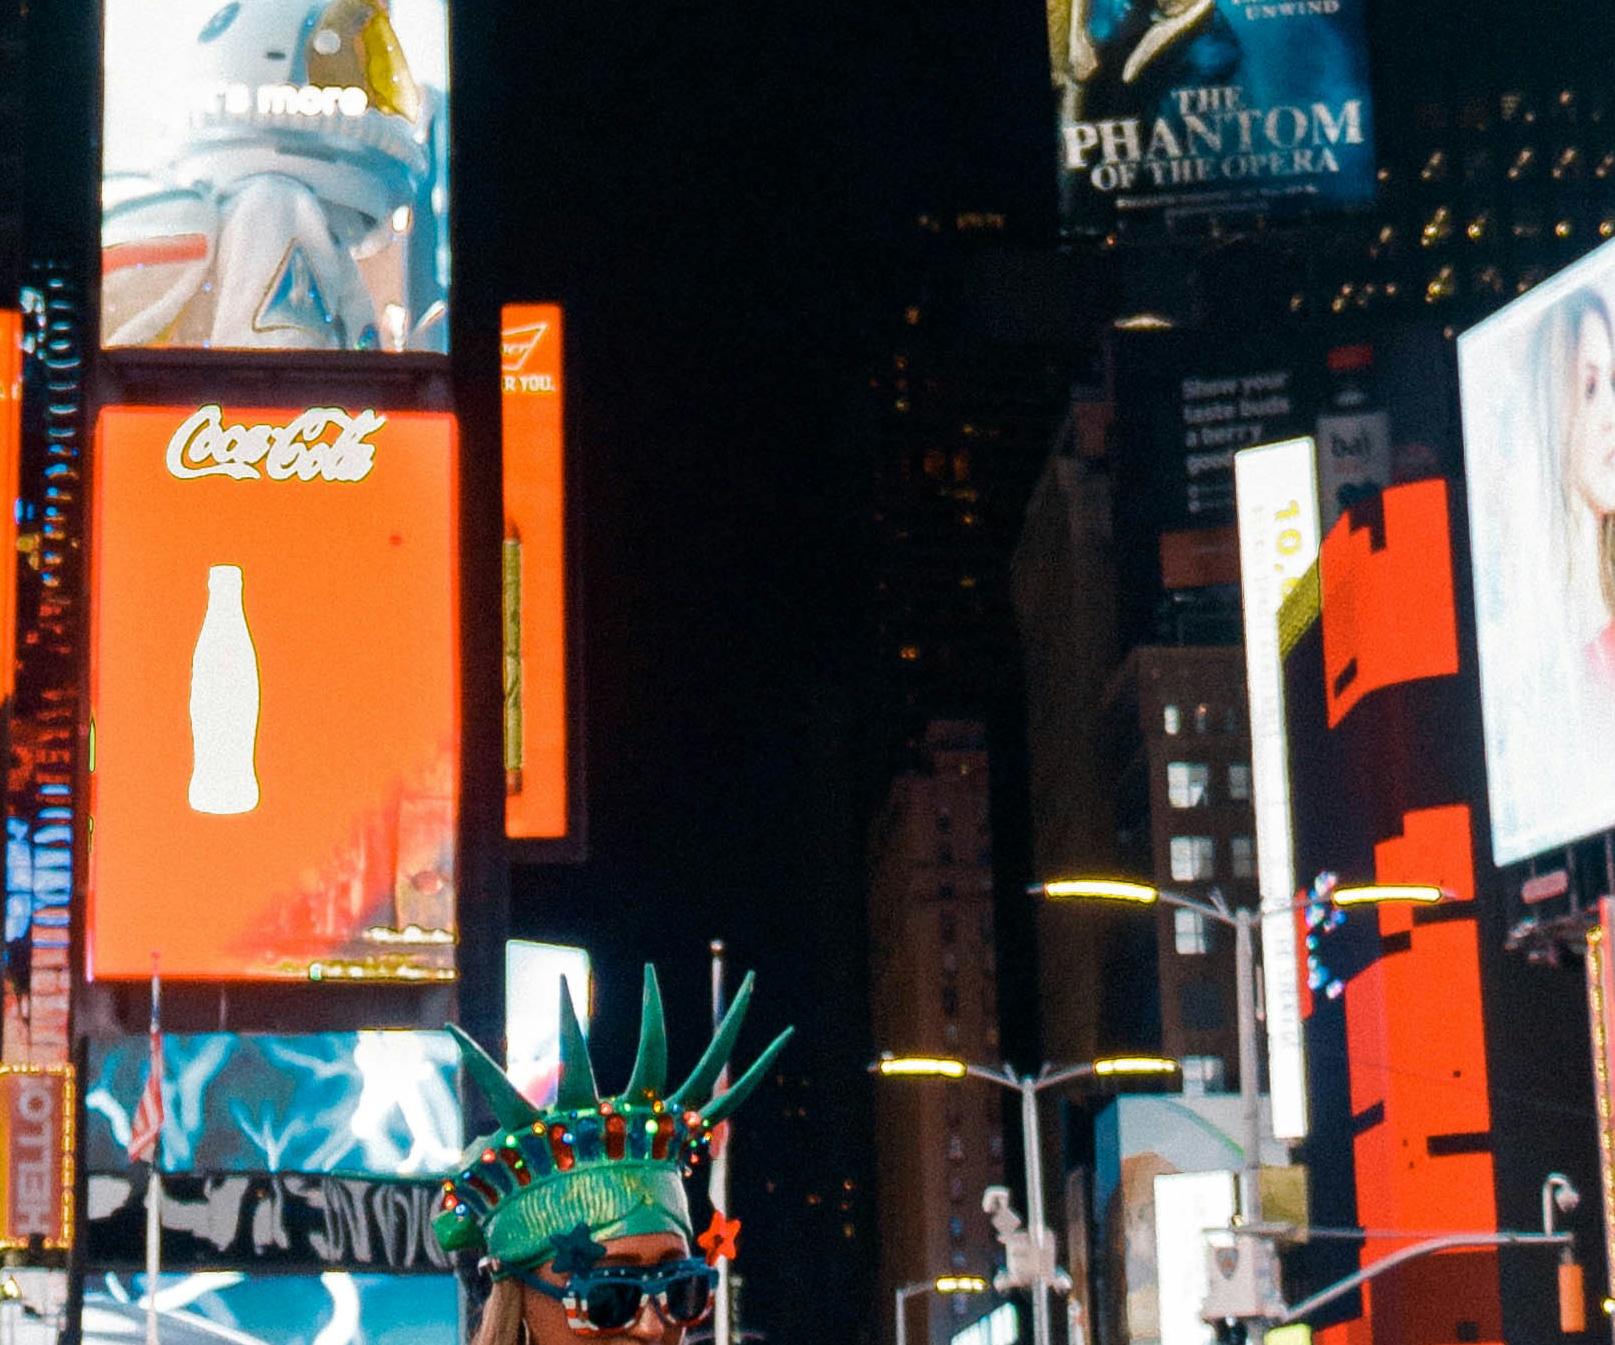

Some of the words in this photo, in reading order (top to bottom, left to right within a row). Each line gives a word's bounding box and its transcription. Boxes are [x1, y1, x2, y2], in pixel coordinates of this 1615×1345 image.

[1170, 85, 1243, 116] THE
[1061, 98, 1365, 169] PHANTOM
[1091, 162, 1136, 191] OF
[1145, 155, 1213, 186] THE
[1221, 147, 1340, 179] OPERA
